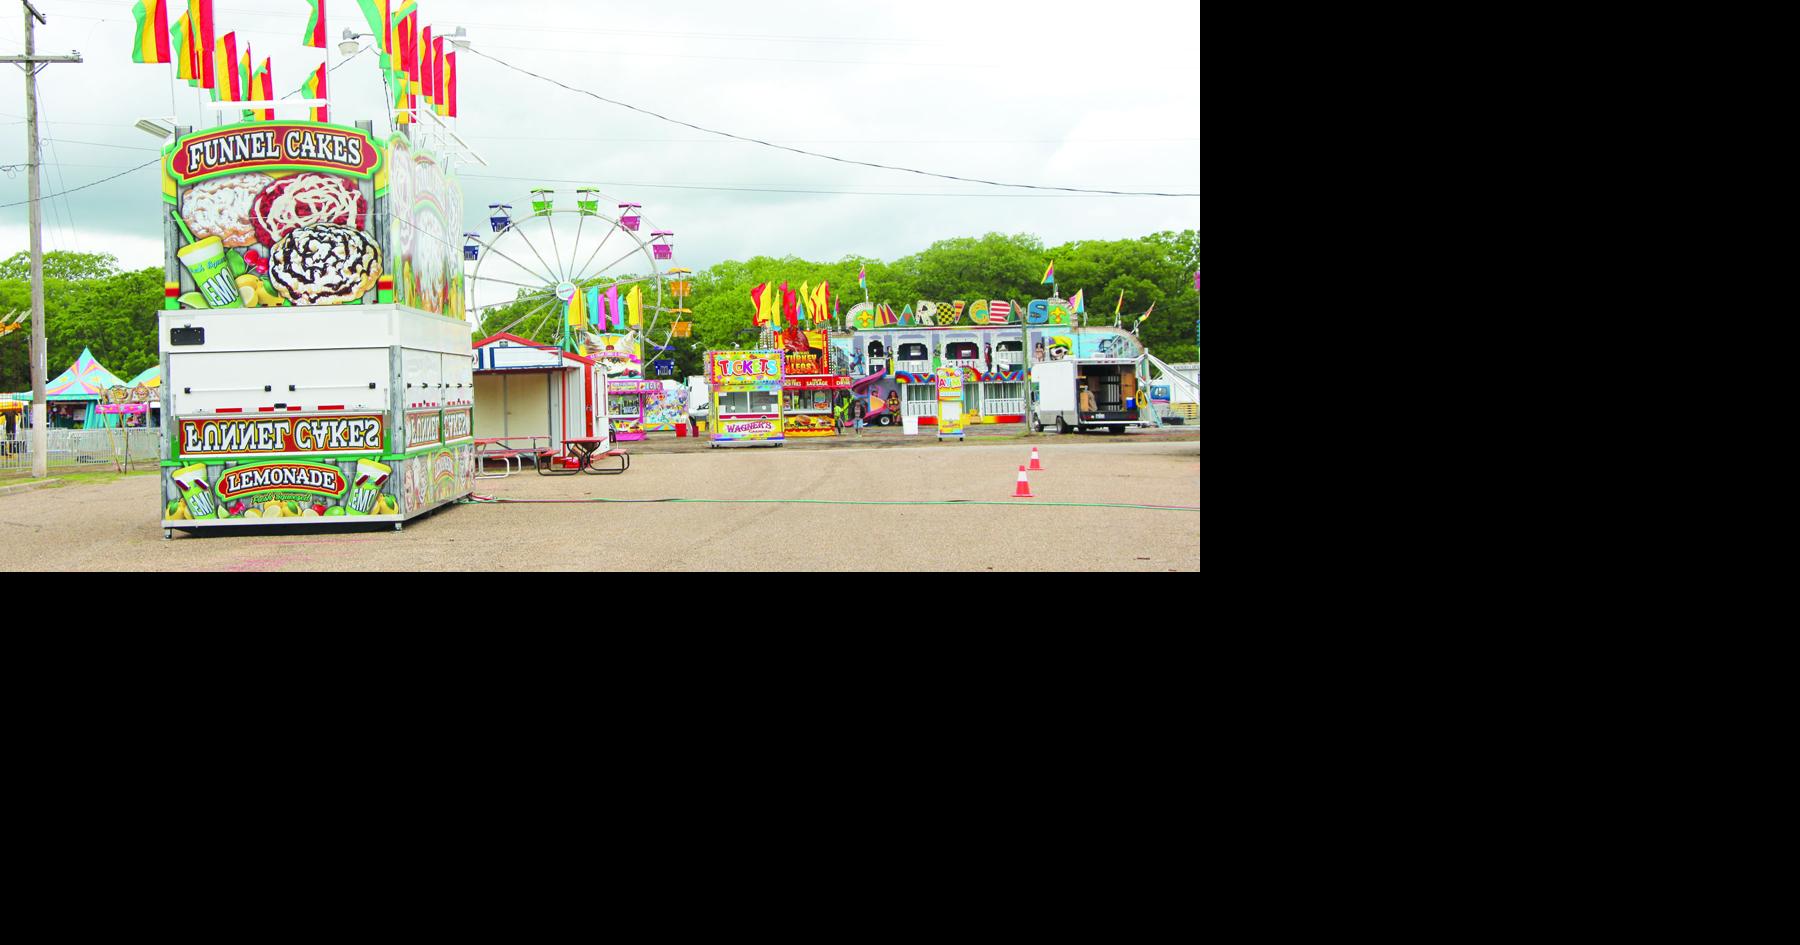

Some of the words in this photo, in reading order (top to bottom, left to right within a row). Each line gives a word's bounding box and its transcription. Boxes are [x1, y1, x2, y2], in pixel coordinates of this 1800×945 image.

[188, 130, 281, 172] FUNNEL
[283, 130, 362, 165] CAKES
[874, 299, 966, 327] MARDI
[968, 299, 1050, 325] GRAS
[719, 358, 778, 376] TICKETS
[726, 421, 772, 433] WAGNER'S
[227, 467, 336, 494] LEMONADE
